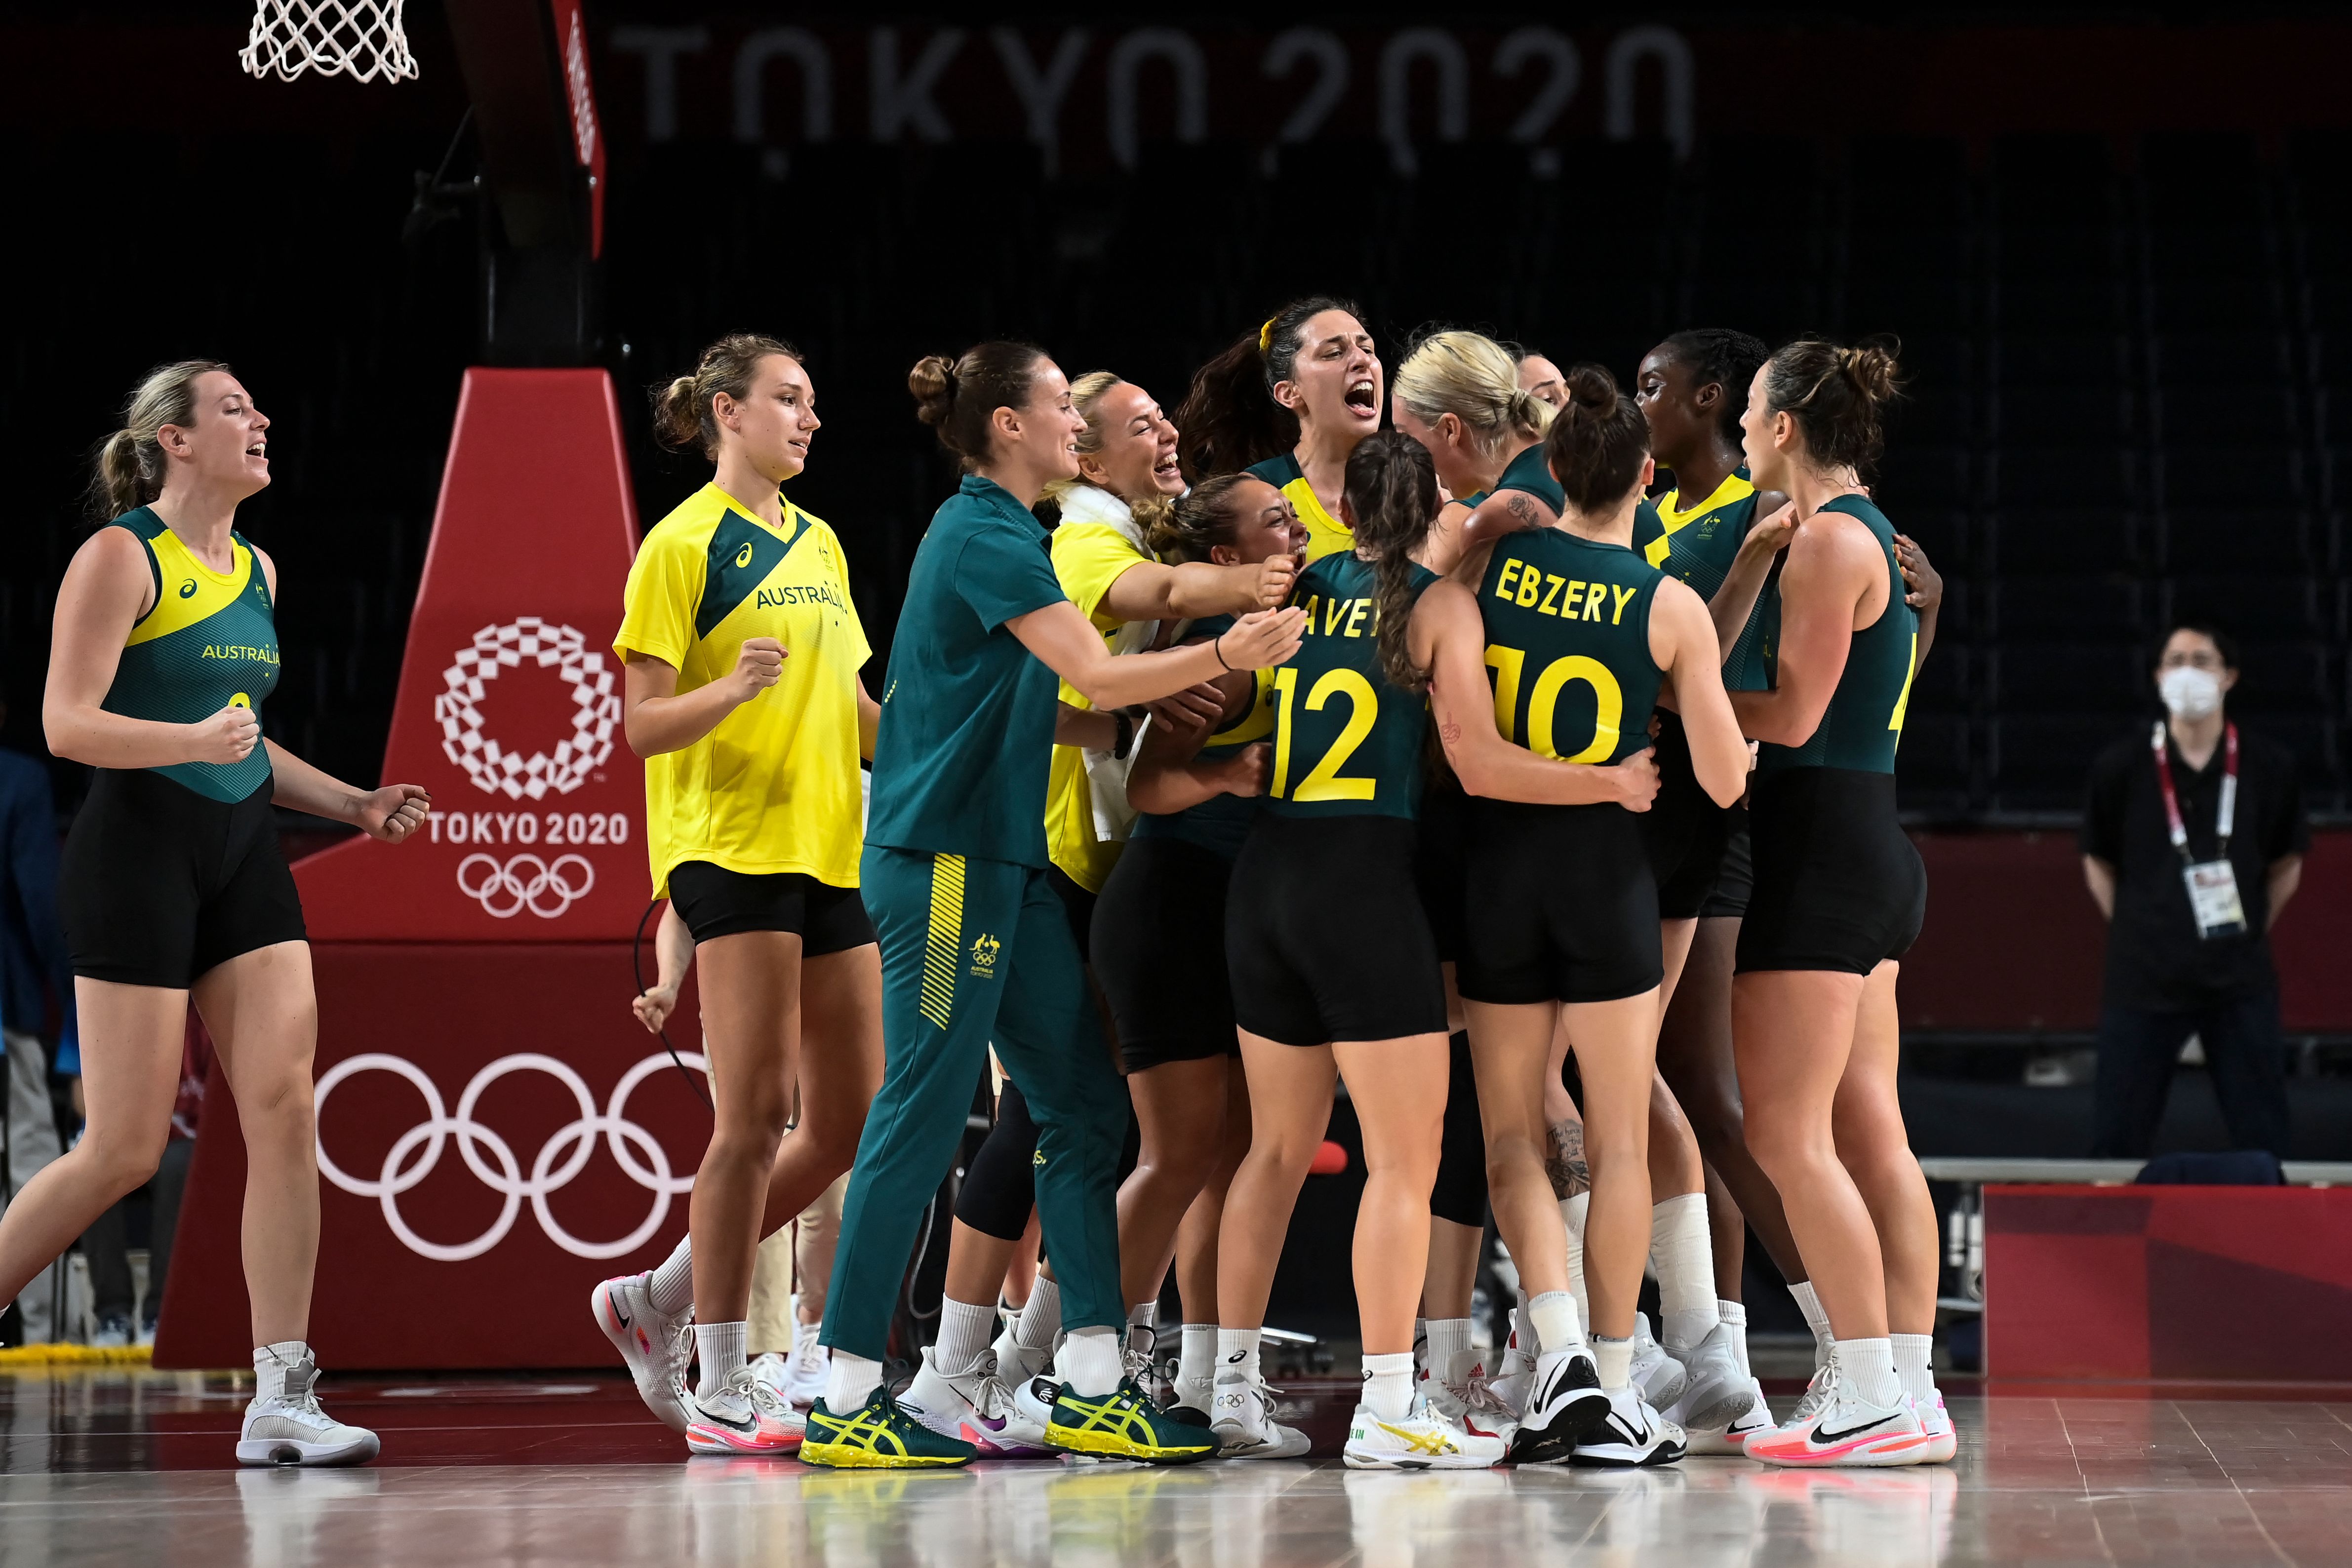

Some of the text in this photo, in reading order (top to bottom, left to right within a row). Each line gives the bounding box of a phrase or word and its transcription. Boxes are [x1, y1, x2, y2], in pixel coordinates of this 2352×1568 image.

[607, 24, 1211, 178] TOKYO
[1258, 24, 1697, 180] 2020
[757, 586, 844, 613] AUSTRALIA
[1495, 557, 1637, 626] EBZERY
[201, 644, 280, 666] AUSTRALIA
[1270, 667, 1379, 802] 12
[1484, 643, 1623, 765] 10
[426, 811, 629, 845] TOKYO 2020
